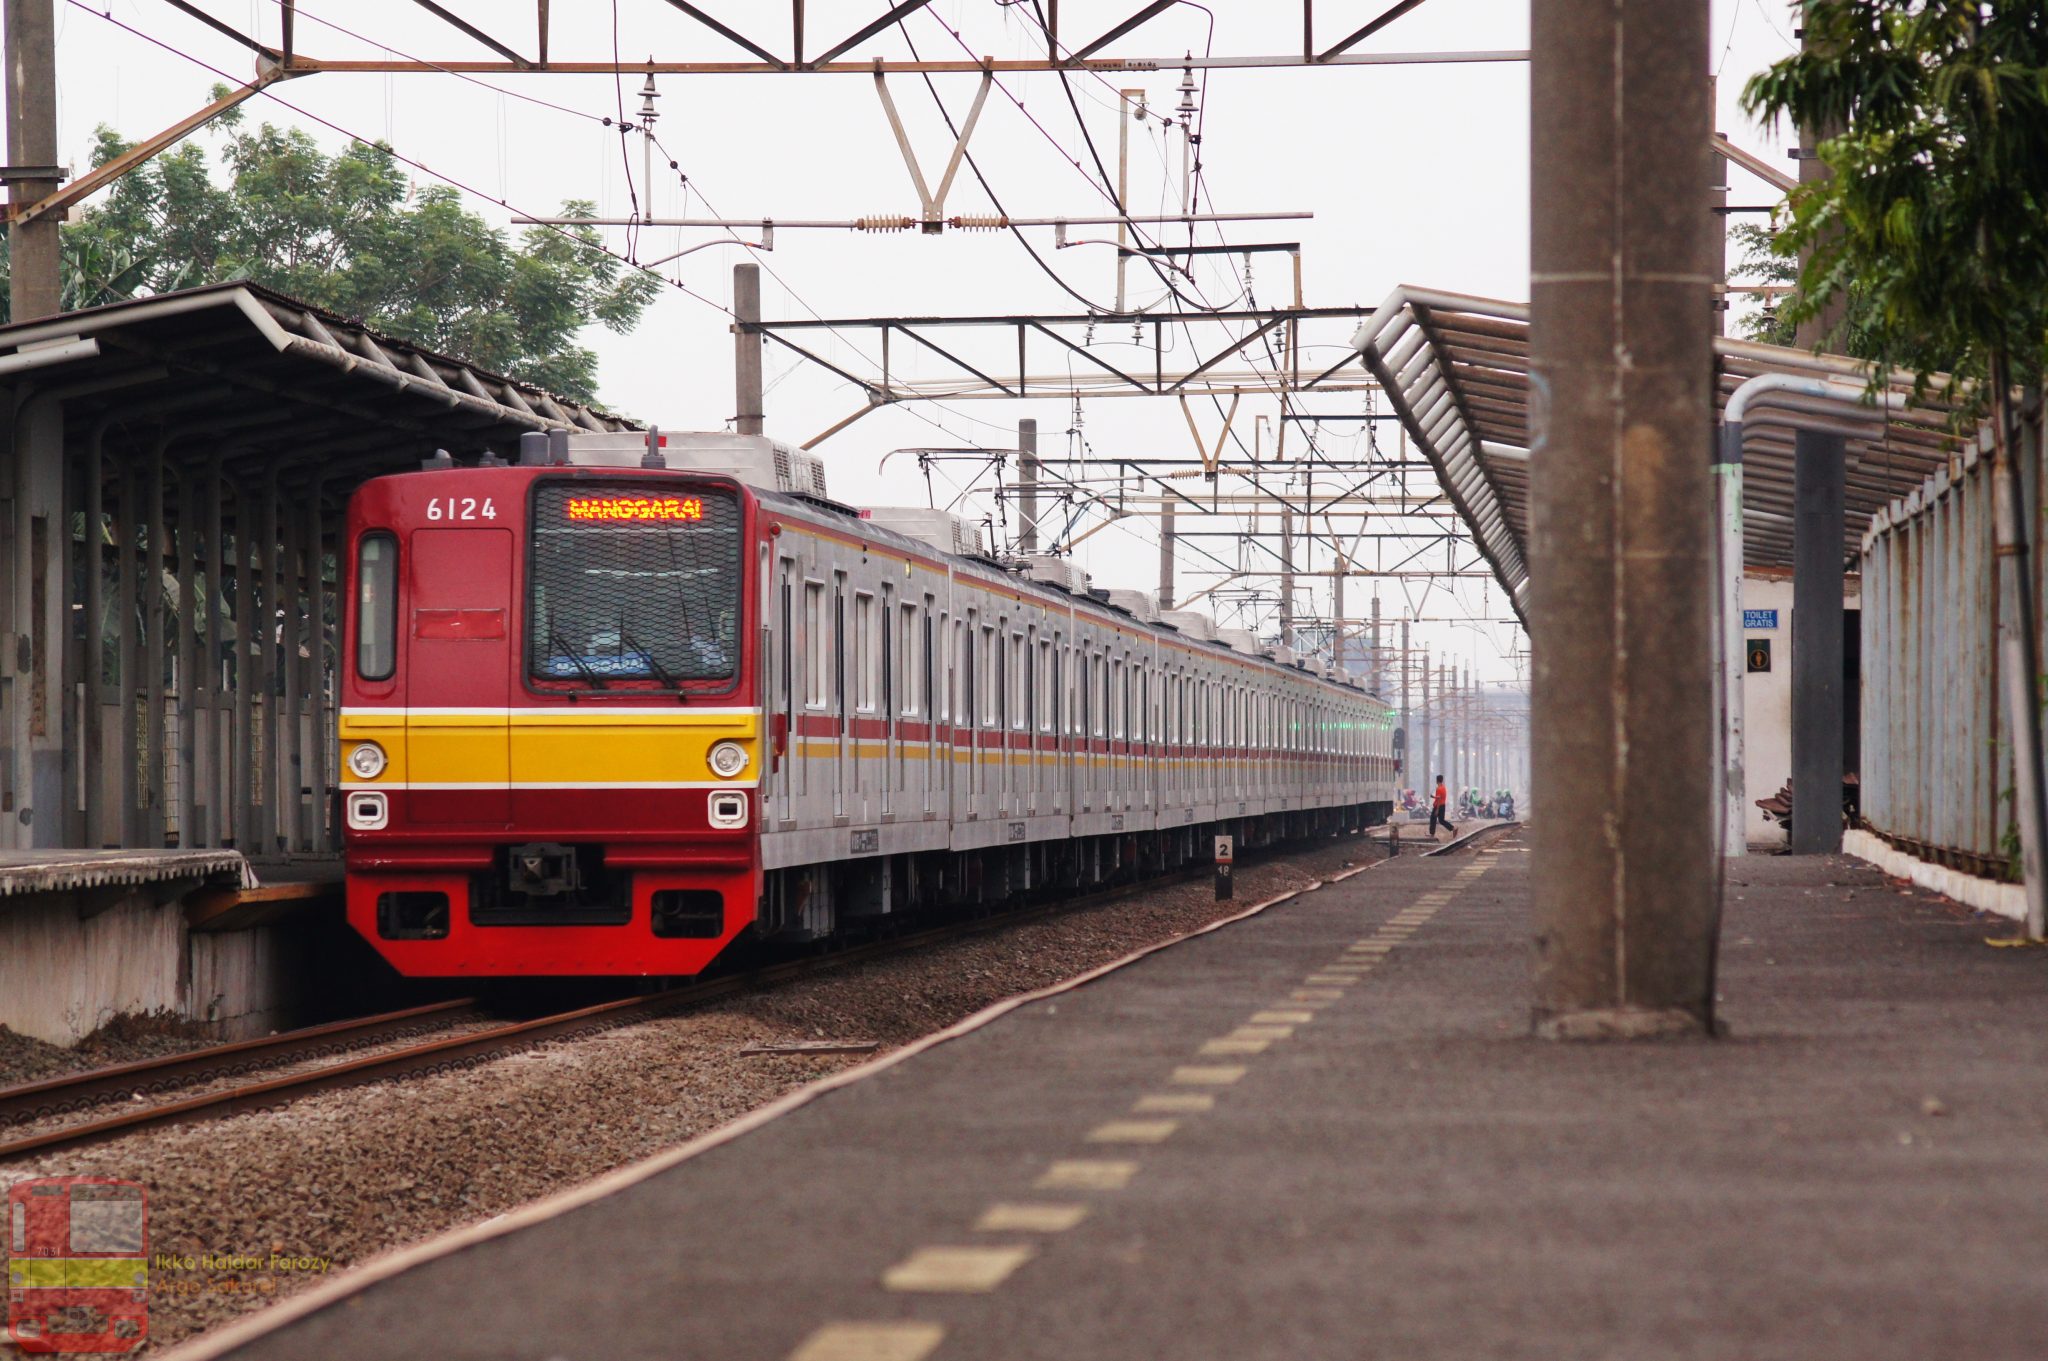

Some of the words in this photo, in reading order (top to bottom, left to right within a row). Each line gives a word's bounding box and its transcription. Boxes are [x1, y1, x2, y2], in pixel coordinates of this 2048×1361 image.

[426, 498, 497, 520] 6124
[568, 498, 701, 519] MANGGARAI
[1745, 611, 1772, 619] TOILET
[1744, 619, 1774, 627] GRATIS
[1219, 843, 1229, 856] 2
